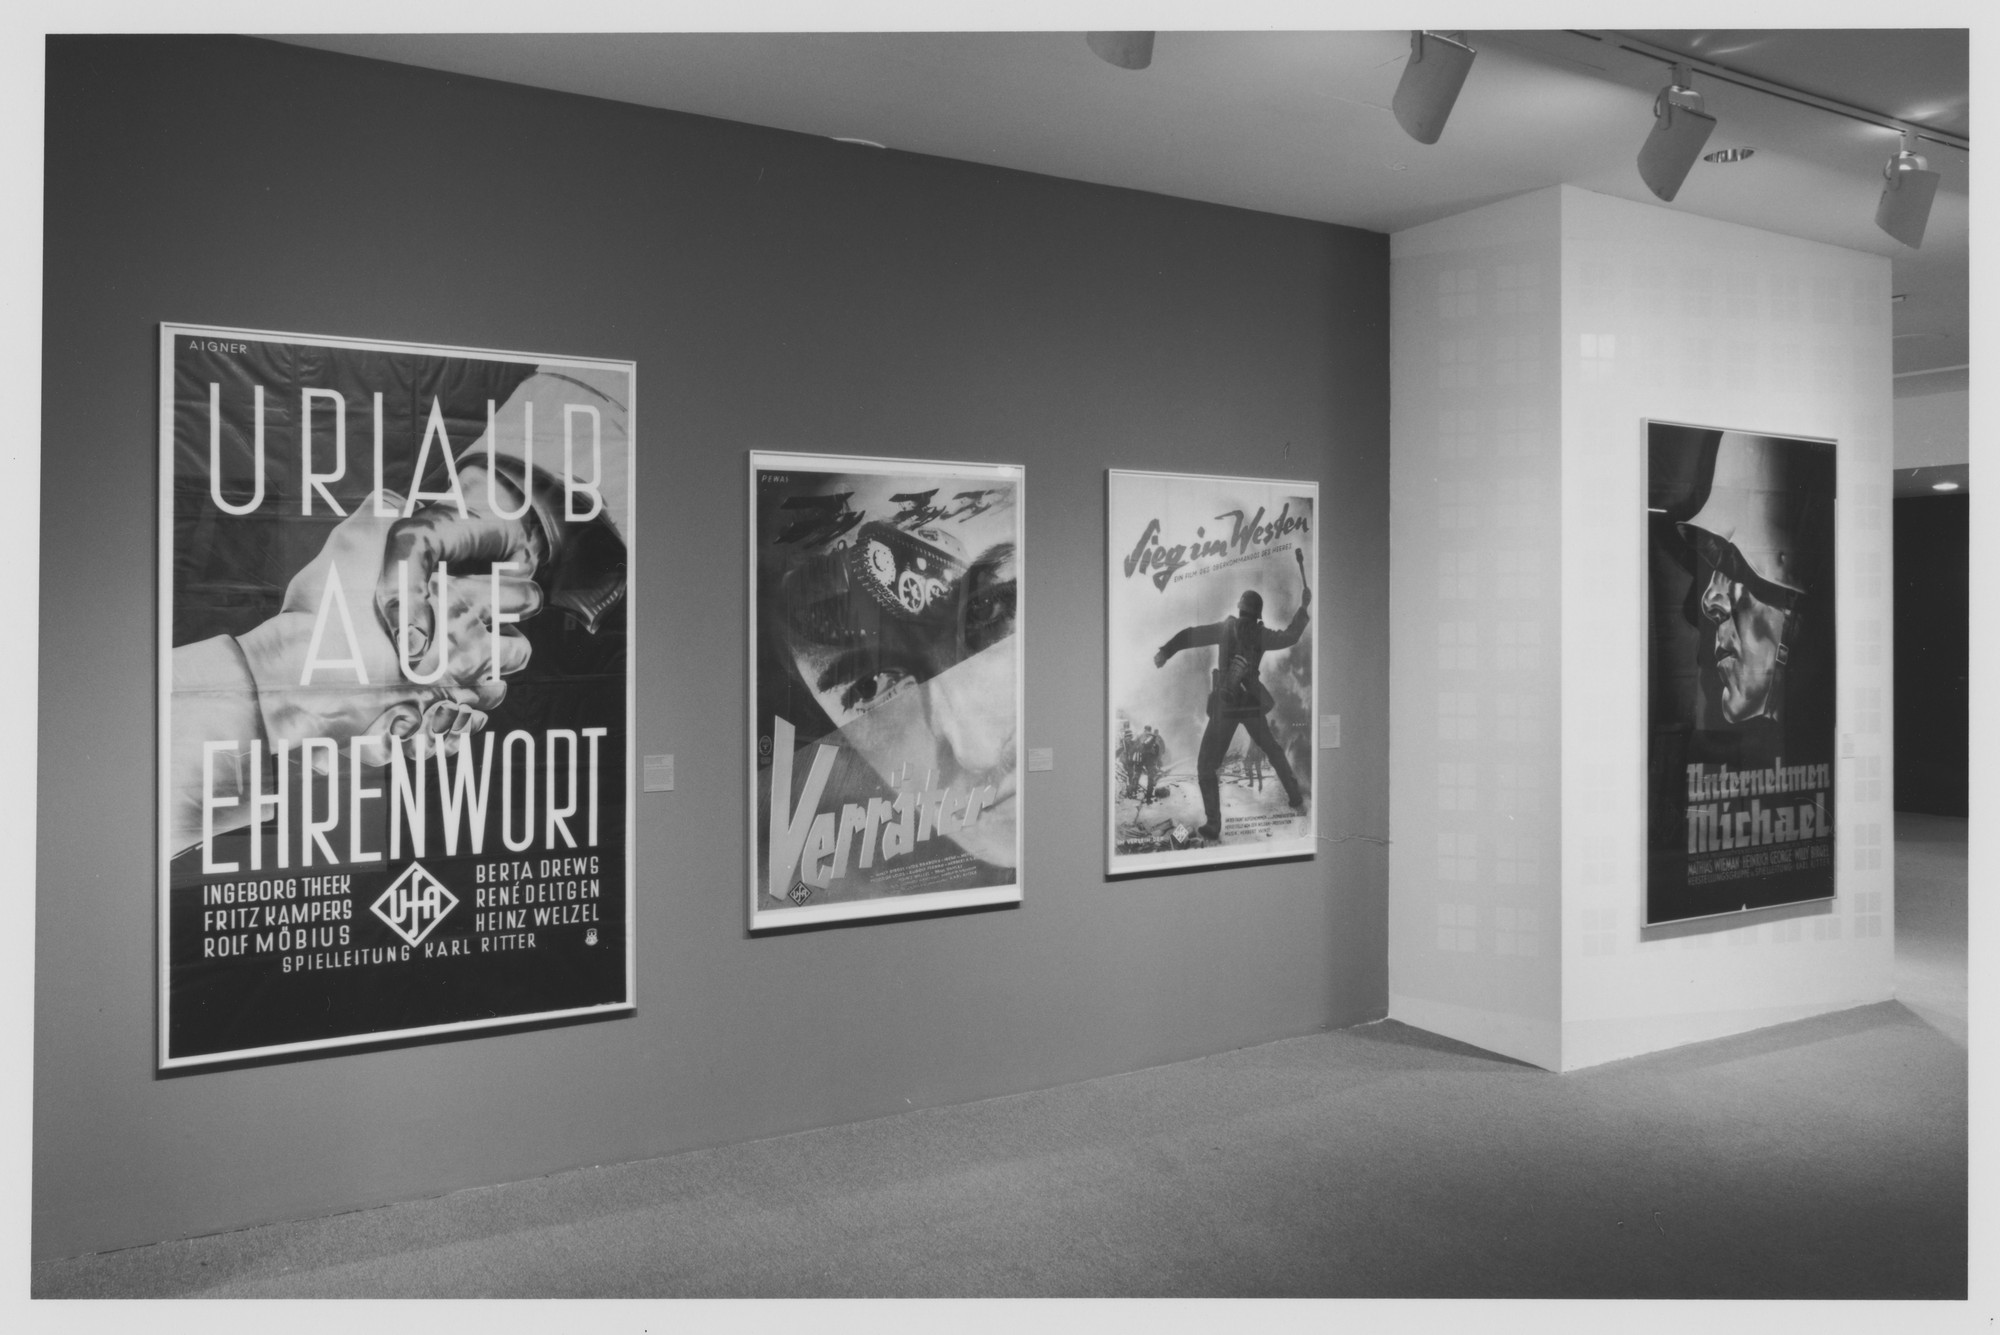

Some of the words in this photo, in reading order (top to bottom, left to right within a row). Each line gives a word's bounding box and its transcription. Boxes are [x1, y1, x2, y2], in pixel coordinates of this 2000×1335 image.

[189, 340, 248, 354] AIGNER
[210, 382, 602, 522] URLAUB
[1190, 526, 1228, 561] im
[1214, 502, 1309, 548] Westen
[1185, 571, 1198, 579] FILM
[299, 559, 521, 686] AUF
[1686, 757, 1831, 802] Unternehmen
[202, 727, 607, 875] EHRENWORT
[1686, 792, 1831, 855] Michael
[476, 860, 533, 884] BERTA
[540, 856, 599, 878] DREWS
[204, 878, 297, 906] INGEBORG
[301, 874, 351, 897] THEEK
[476, 880, 521, 908] RENÉ
[525, 879, 600, 904] DELTGEN
[205, 907, 259, 931] FRITZ
[265, 899, 352, 926] KAMPERS
[476, 909, 526, 933] HEINZ
[533, 903, 600, 927] WELZEL
[204, 936, 249, 958] ROLF
[256, 925, 350, 952] MÖBIUS
[282, 944, 410, 973] SPIELLEITUNG
[425, 939, 471, 959] KARL
[481, 932, 536, 952] RITTER
